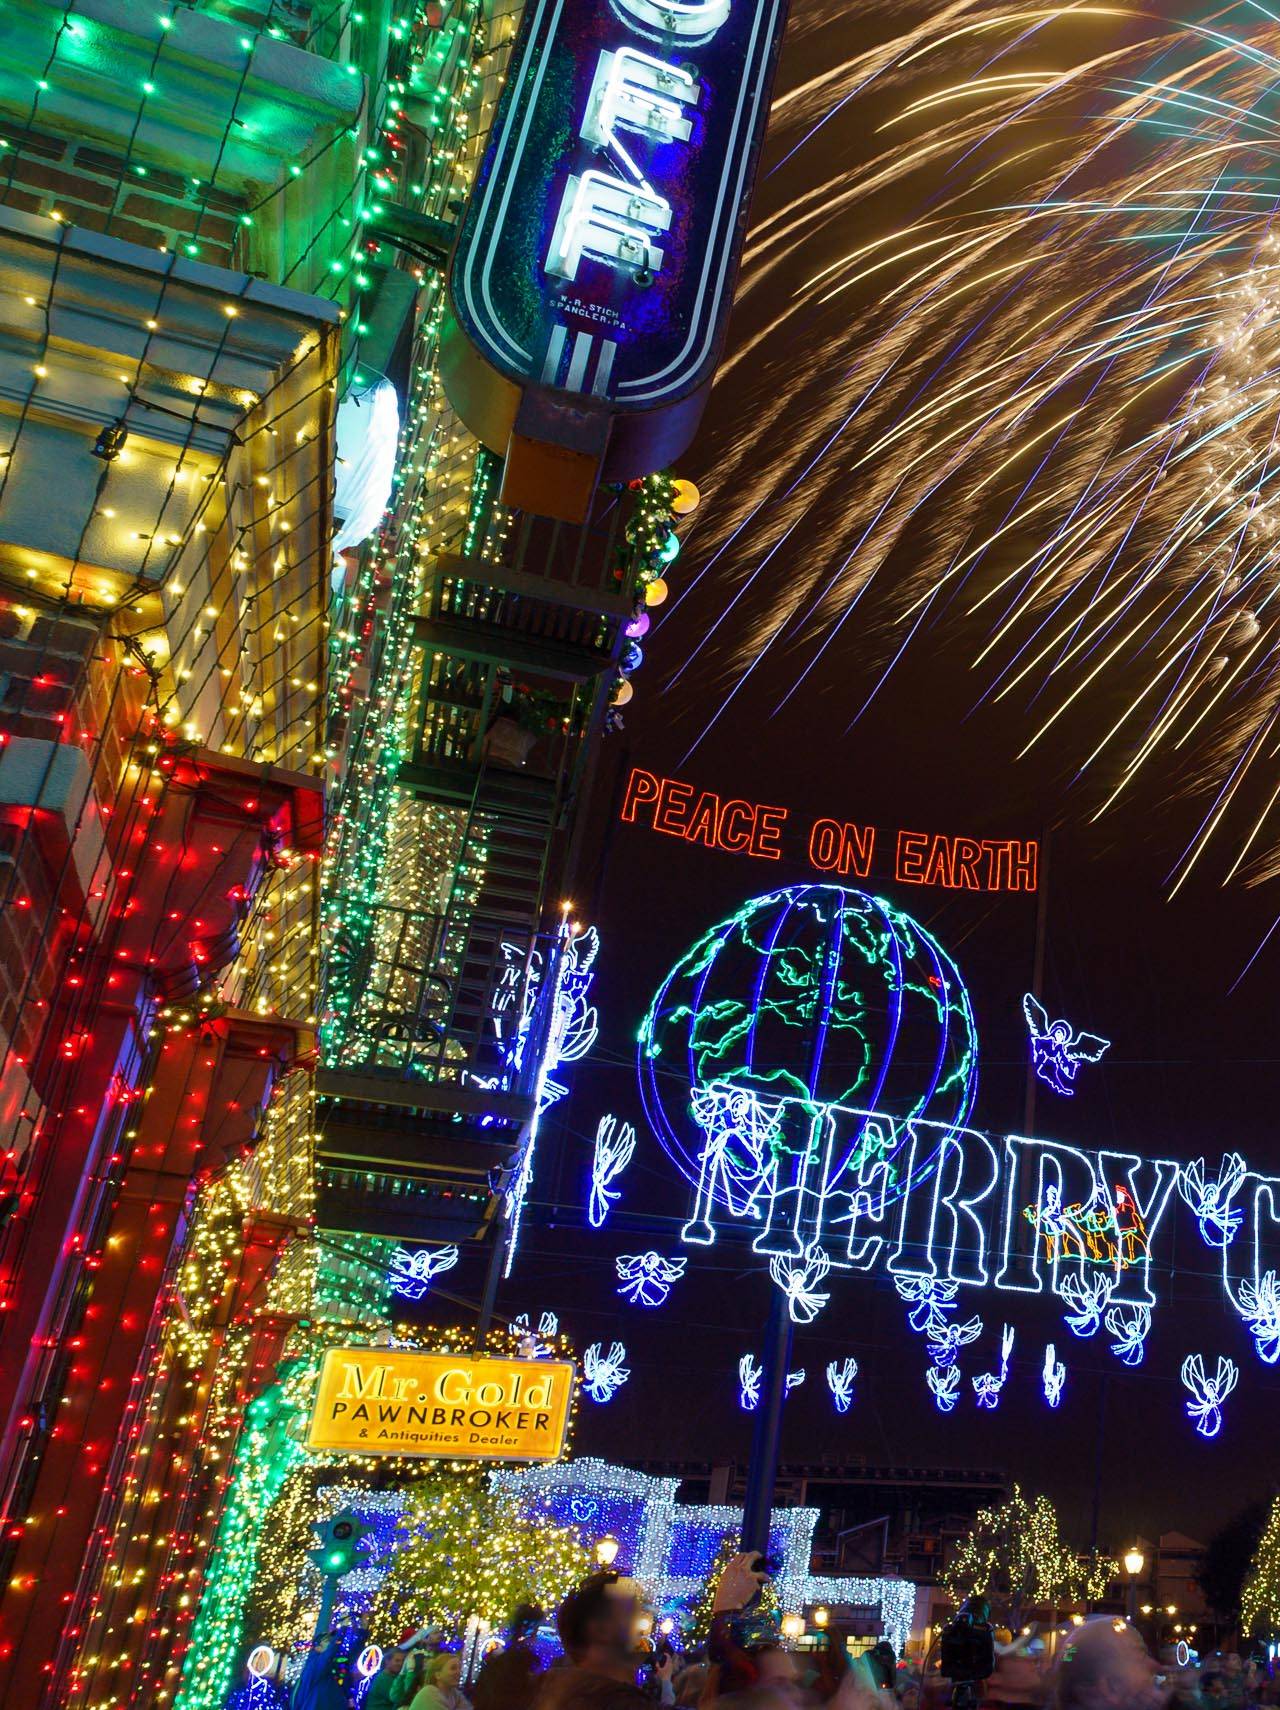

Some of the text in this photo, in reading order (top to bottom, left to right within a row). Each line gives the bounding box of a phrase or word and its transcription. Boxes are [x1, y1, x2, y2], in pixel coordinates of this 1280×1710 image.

[621, 767, 1038, 891] PEACE ON EARTH
[681, 1082, 1180, 1307] MERRY
[434, 1368, 554, 1410] Gold
[331, 1402, 550, 1431] PAWNBROKER
[358, 1428, 519, 1446] & Antiquities Dealer
